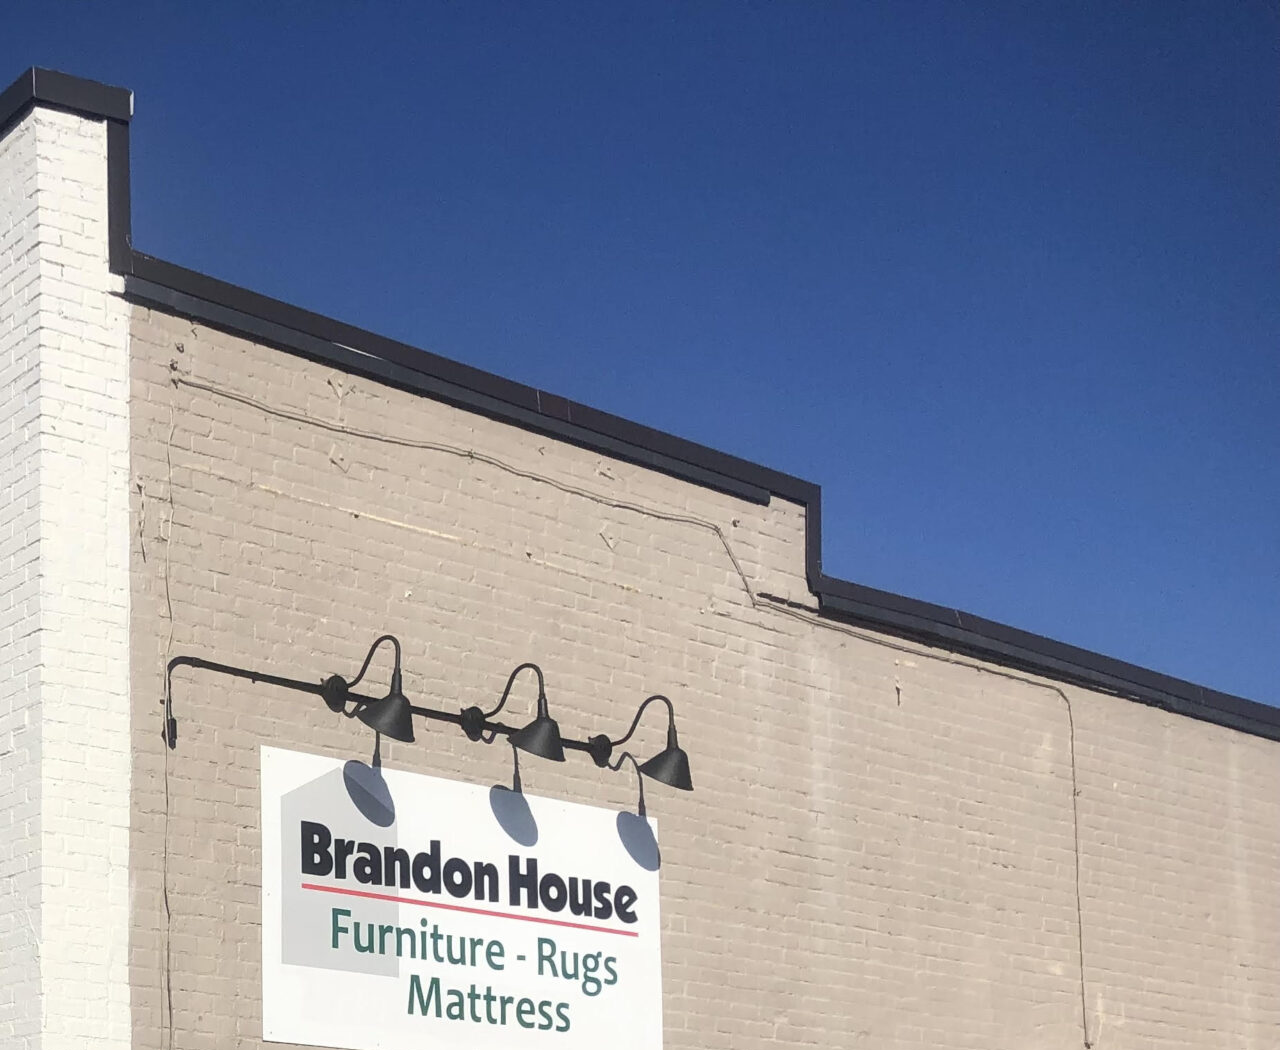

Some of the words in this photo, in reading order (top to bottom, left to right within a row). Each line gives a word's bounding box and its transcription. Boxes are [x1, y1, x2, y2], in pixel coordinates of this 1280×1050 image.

[300, 820, 499, 902] Brandon
[508, 855, 639, 924] House
[331, 907, 505, 971] Furniture
[537, 937, 619, 996] Rugs
[407, 974, 571, 1033] Mattress
